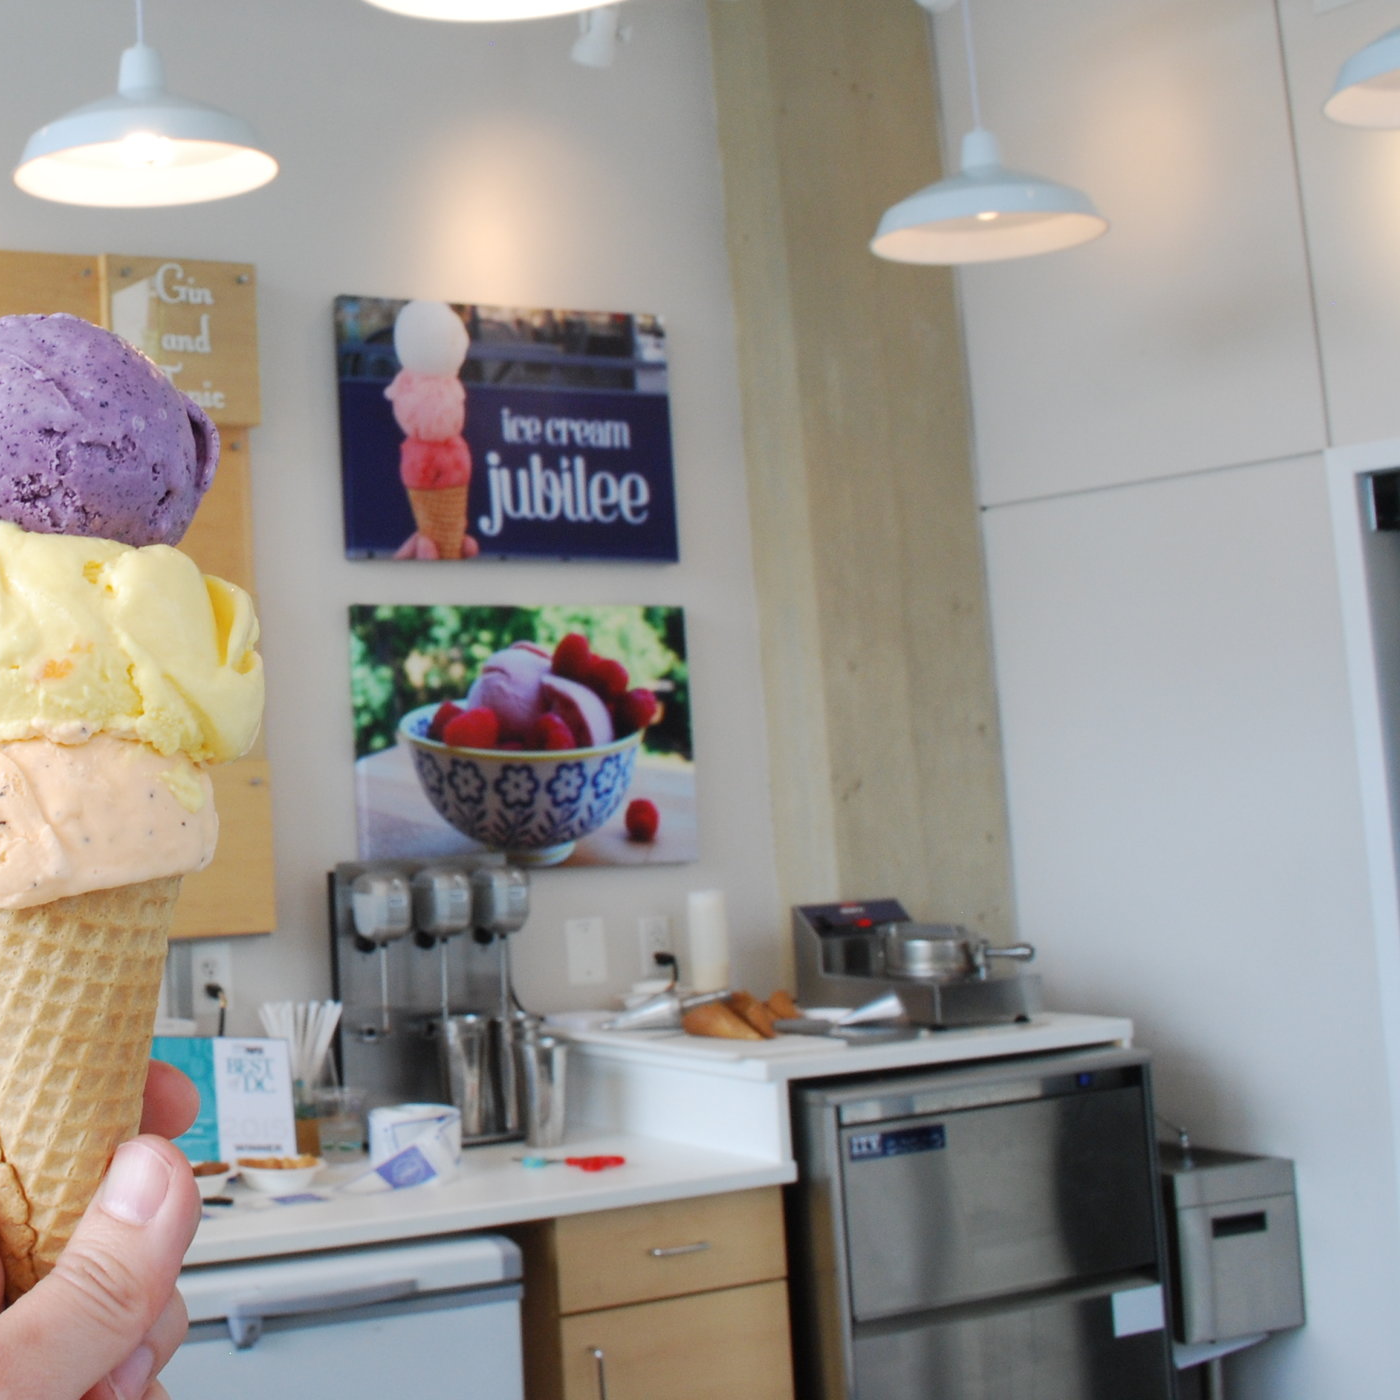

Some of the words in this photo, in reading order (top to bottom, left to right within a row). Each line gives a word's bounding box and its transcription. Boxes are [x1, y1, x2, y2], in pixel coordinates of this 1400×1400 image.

[155, 263, 214, 304] Gin
[161, 313, 211, 353] and
[500, 408, 543, 444] ice
[546, 418, 631, 449] cream
[478, 451, 651, 537] jubilee
[226, 1057, 275, 1078] BEST
[234, 1144, 283, 1154] WINNER
